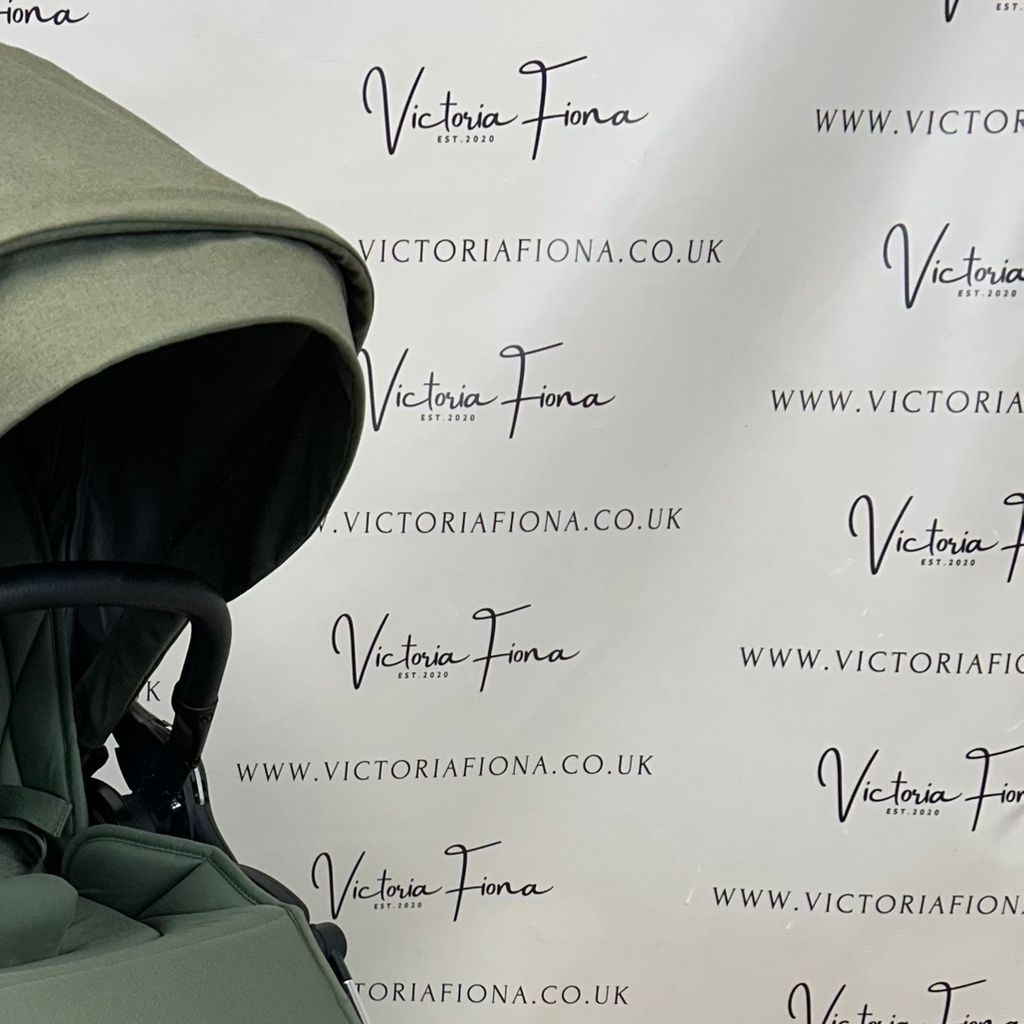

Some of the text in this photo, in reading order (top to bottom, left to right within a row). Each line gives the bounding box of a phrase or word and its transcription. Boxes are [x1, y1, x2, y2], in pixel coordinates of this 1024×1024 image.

[361, 55, 649, 161] Victoria Fiona
[436, 134, 495, 144] EST.2020
[882, 222, 1024, 310] Victoria
[957, 288, 1018, 299] EST.2020
[361, 341, 617, 440] Victoria Fiona
[420, 413, 476, 422] EST.2020
[847, 494, 1000, 576] Victoria
[920, 558, 976, 567] EST.2020
[330, 603, 581, 693] Victoria Fiona
[397, 670, 449, 680] EST.2020
[236, 753, 654, 783] WWW.VICTORIAFIONA.CO.UK
[816, 746, 964, 824] Victoria
[885, 807, 941, 817] EST.2020
[308, 840, 555, 923] Victoria Fiona
[373, 900, 423, 910] EST.2020
[712, 886, 1024, 916] WWW.VICTORIAFION
